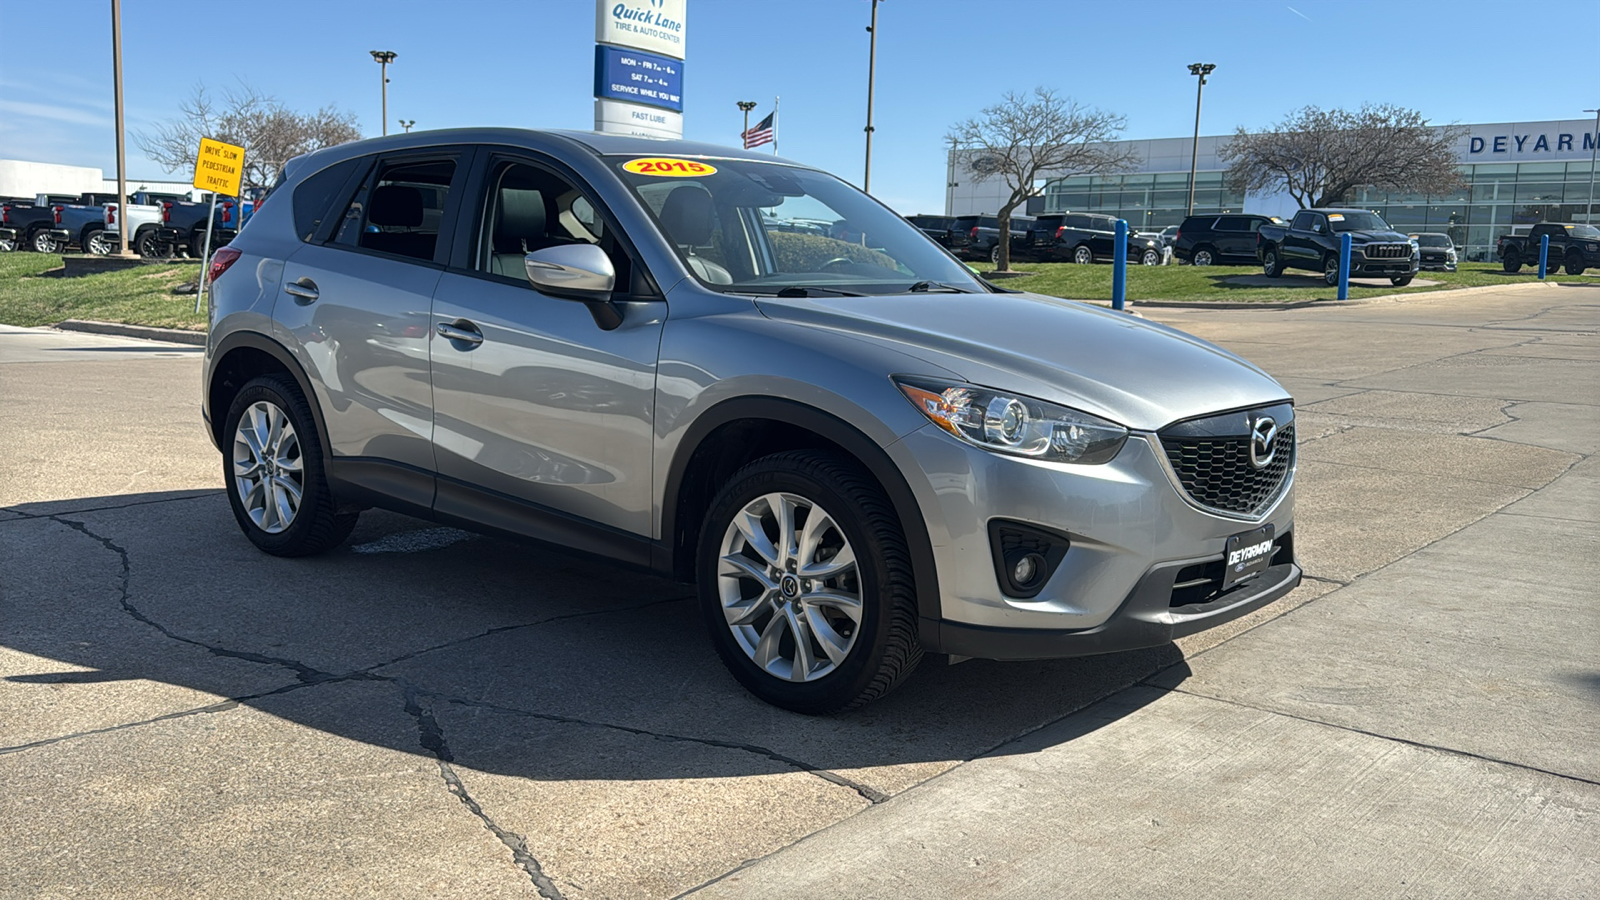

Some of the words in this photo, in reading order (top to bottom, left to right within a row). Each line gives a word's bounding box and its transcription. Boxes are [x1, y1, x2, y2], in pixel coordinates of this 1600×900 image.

[613, 3, 654, 24] Quick
[654, 12, 681, 32] Lane
[615, 21, 632, 32] TIRE
[633, 25, 639, 33] &
[640, 27, 658, 37] AUTO
[659, 31, 680, 44] CENTER
[621, 57, 636, 66] MON
[642, 61, 652, 69] FRI
[631, 73, 643, 81] SAT
[611, 84, 638, 95] SERVICE
[640, 88, 657, 98] WHILE
[658, 92, 670, 100] YOU
[632, 111, 648, 121] FAST
[649, 114, 666, 124] LUBE
[1470, 132, 1600, 153] DEYARM
[205, 145, 221, 157] DRIVE
[223, 150, 237, 160] SLOW
[202, 159, 235, 174] PEDESTRIAN
[637, 162, 705, 172] 2015
[206, 175, 229, 188] TRAFFIC
[1228, 539, 1273, 565] DEYARMAN
